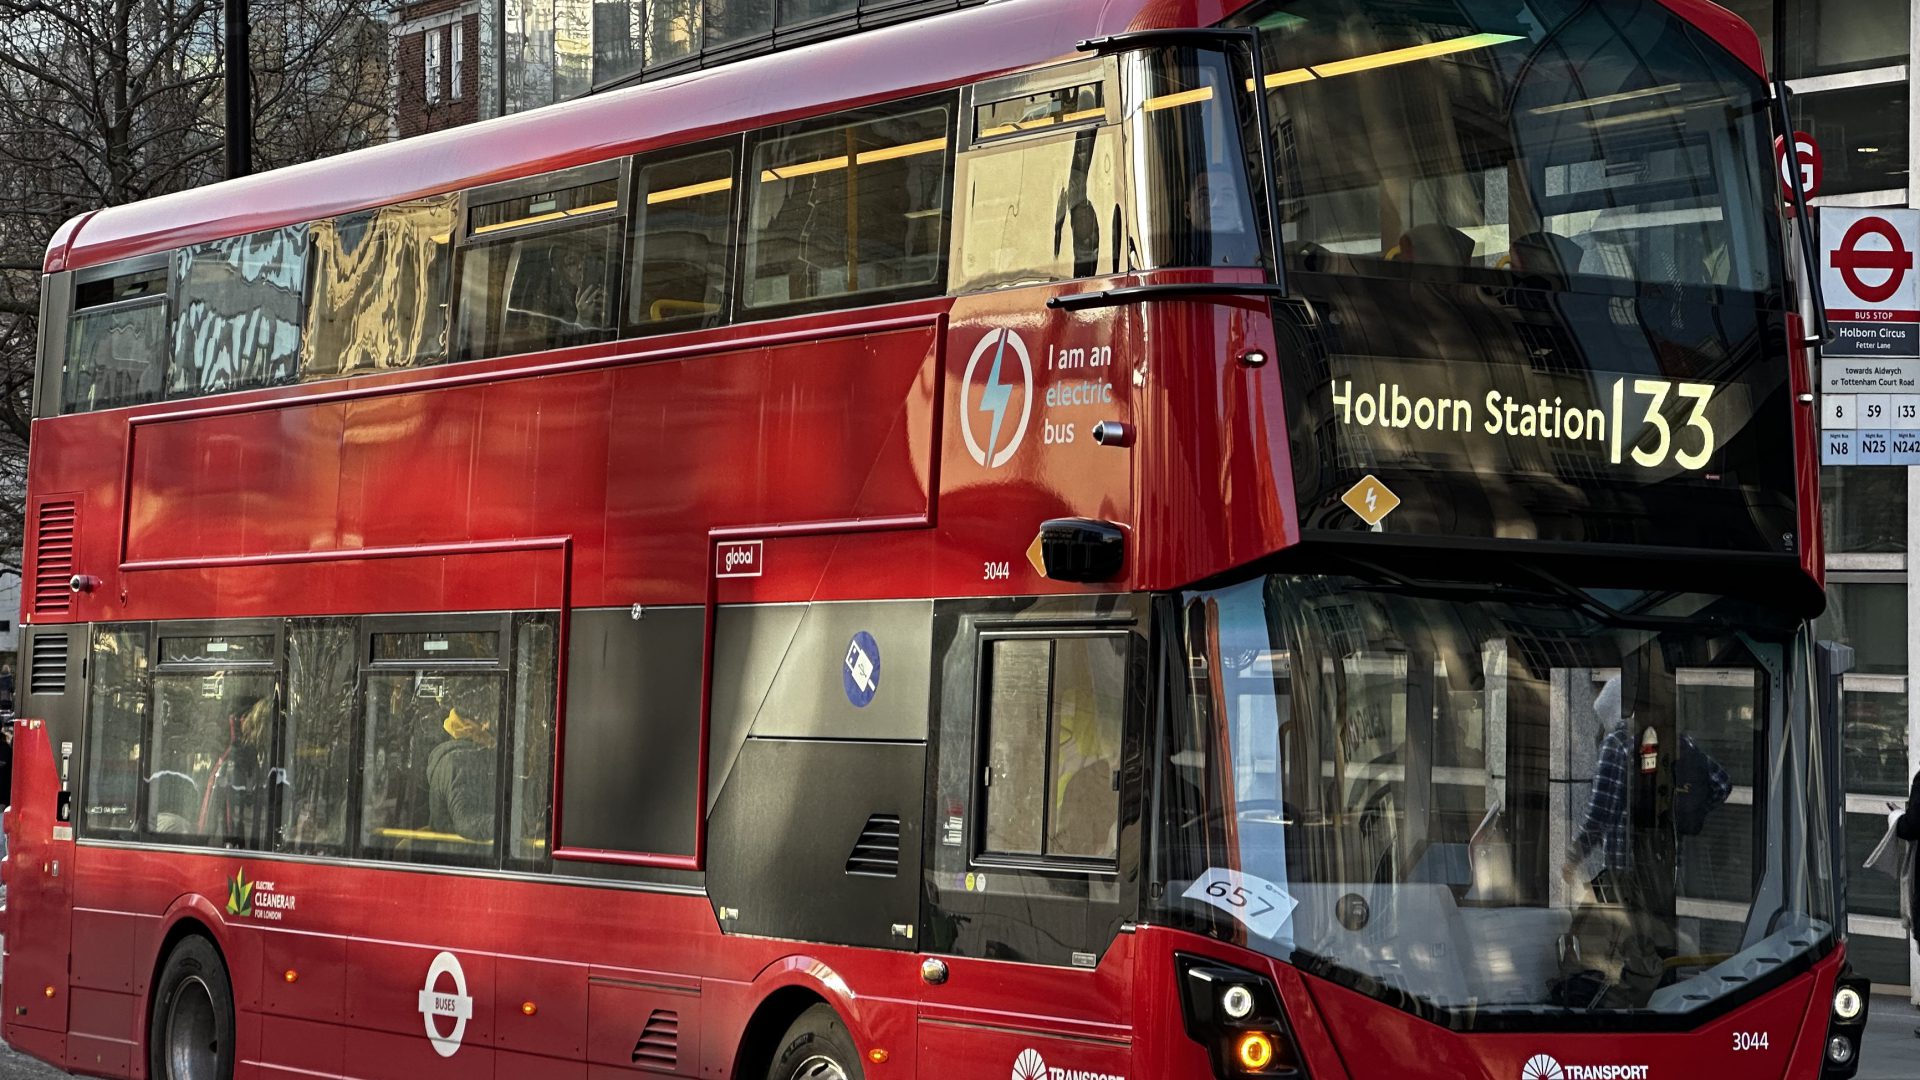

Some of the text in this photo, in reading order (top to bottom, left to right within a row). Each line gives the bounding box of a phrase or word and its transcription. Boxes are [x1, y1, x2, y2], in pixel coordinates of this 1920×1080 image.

[1781, 141, 1814, 193] G
[1855, 311, 1893, 320] BUS STOP
[1839, 327, 1906, 338] Holborn Circus
[1855, 341, 1875, 349] Fetter
[1048, 344, 1112, 370] I am an
[1845, 367, 1902, 376] towards Aldwych
[1840, 378, 1877, 386] Tottenham
[1878, 378, 1897, 386] Court
[1899, 378, 1915, 386] Road
[1045, 377, 1112, 408] electric
[1331, 379, 1605, 441] Holborn Station
[1835, 405, 1843, 418] 8
[1867, 404, 1882, 418] 59
[1897, 404, 1916, 418] 133
[1610, 376, 1716, 470] 133
[1044, 418, 1075, 444] bus
[1830, 442, 1848, 455] N8
[1862, 440, 1886, 453] N25
[1893, 440, 1920, 453] N242
[725, 545, 753, 572] global
[983, 561, 1010, 580] 3044
[1206, 881, 1275, 917] 657
[254, 909, 282, 921] FOR LONDON
[435, 997, 456, 1012] BUSES
[1732, 1031, 1769, 1051] 3044
[1048, 1066, 1125, 1080] TRANS
[1564, 1065, 1649, 1080] TRANSPORT
